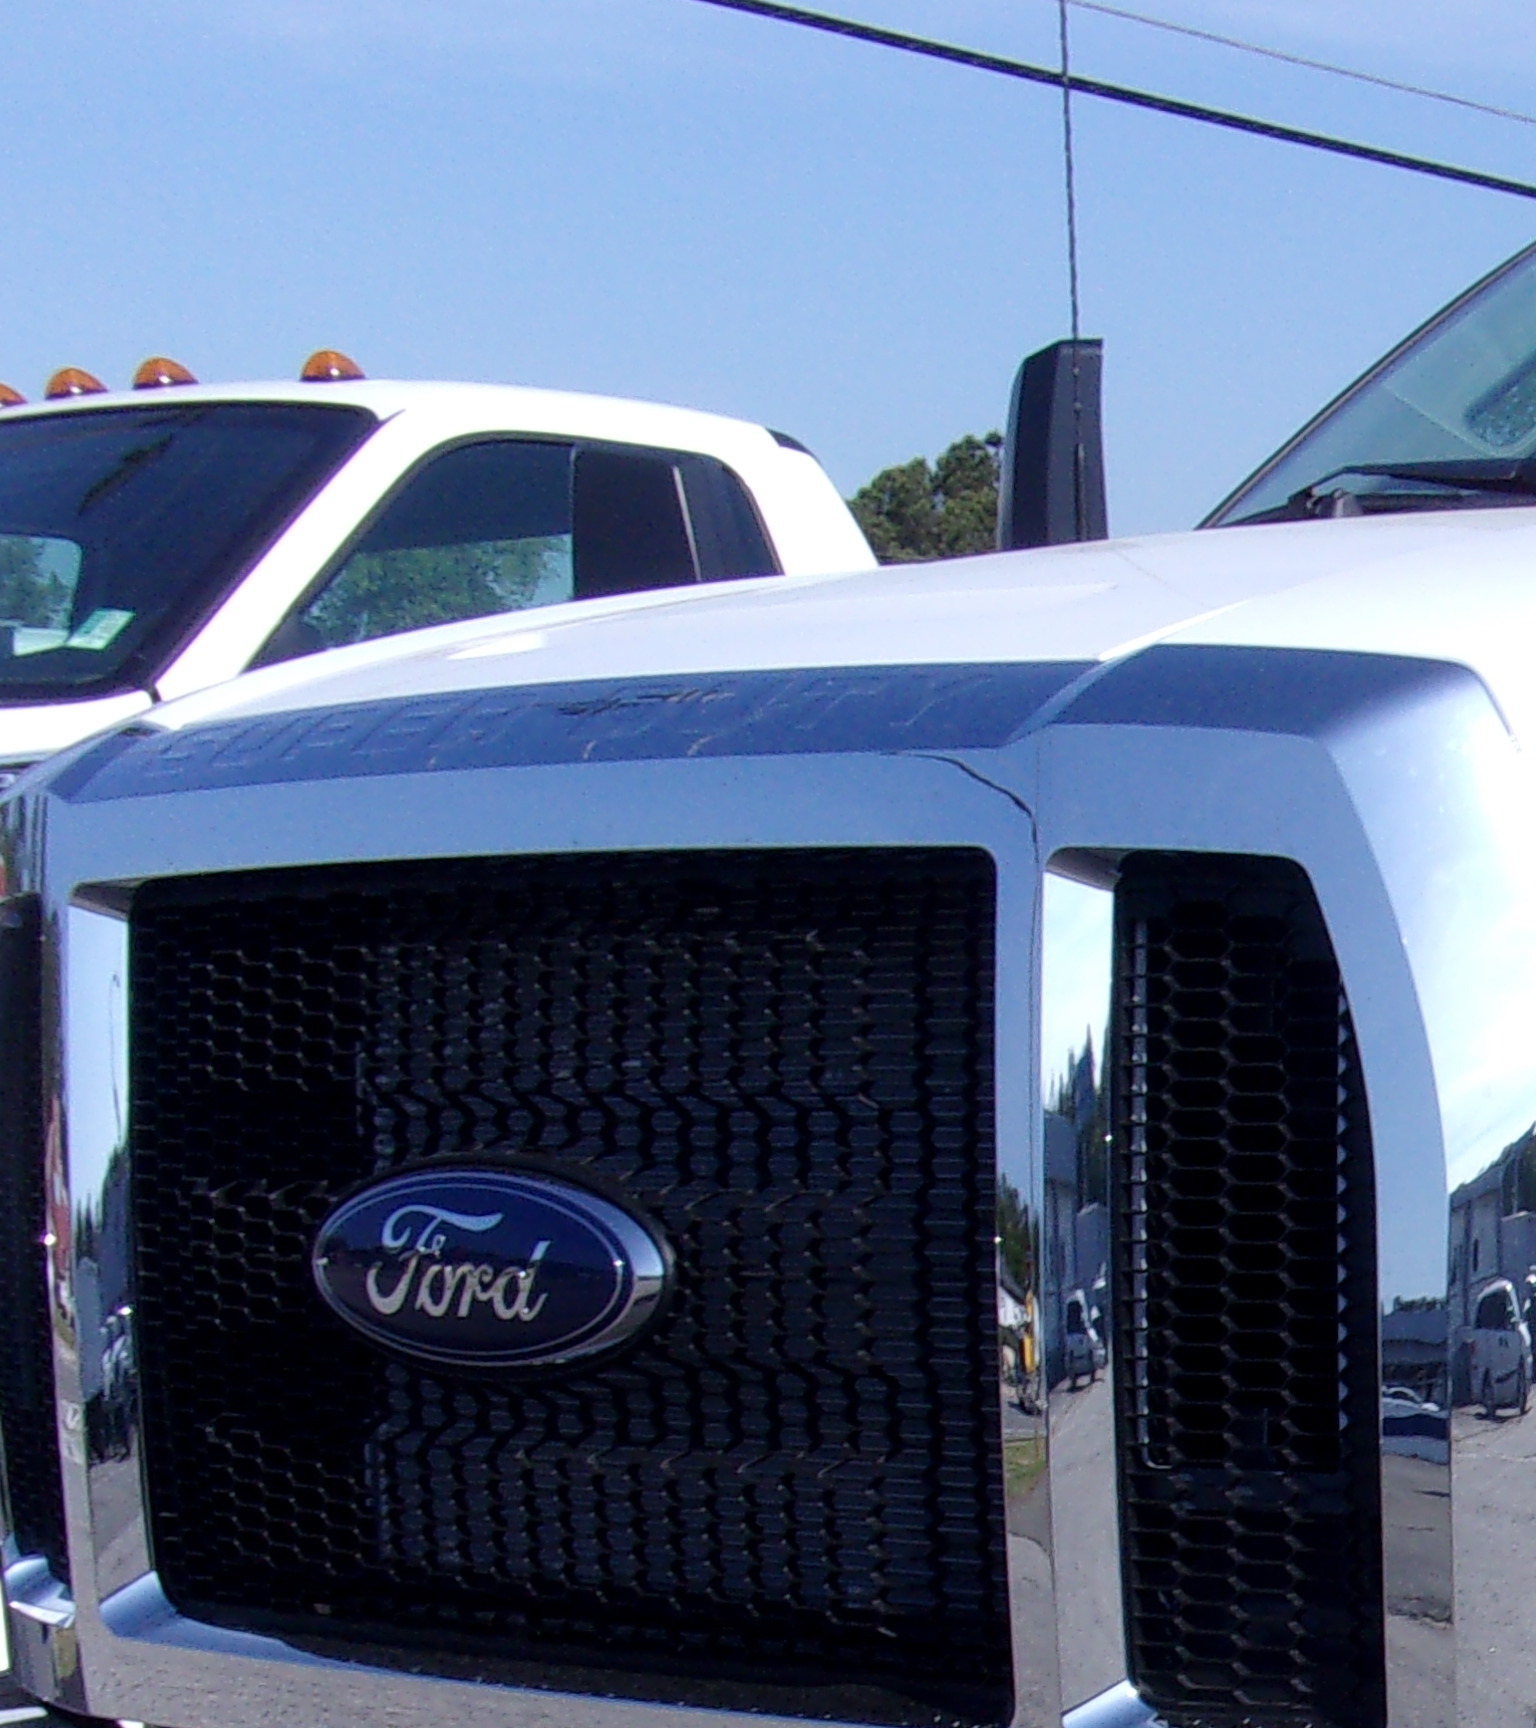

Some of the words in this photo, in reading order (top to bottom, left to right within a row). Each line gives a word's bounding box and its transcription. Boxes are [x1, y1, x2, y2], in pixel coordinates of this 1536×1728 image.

[144, 692, 542, 777] SUPER
[566, 672, 1000, 738] DUTY
[366, 1204, 552, 1322] Ford
